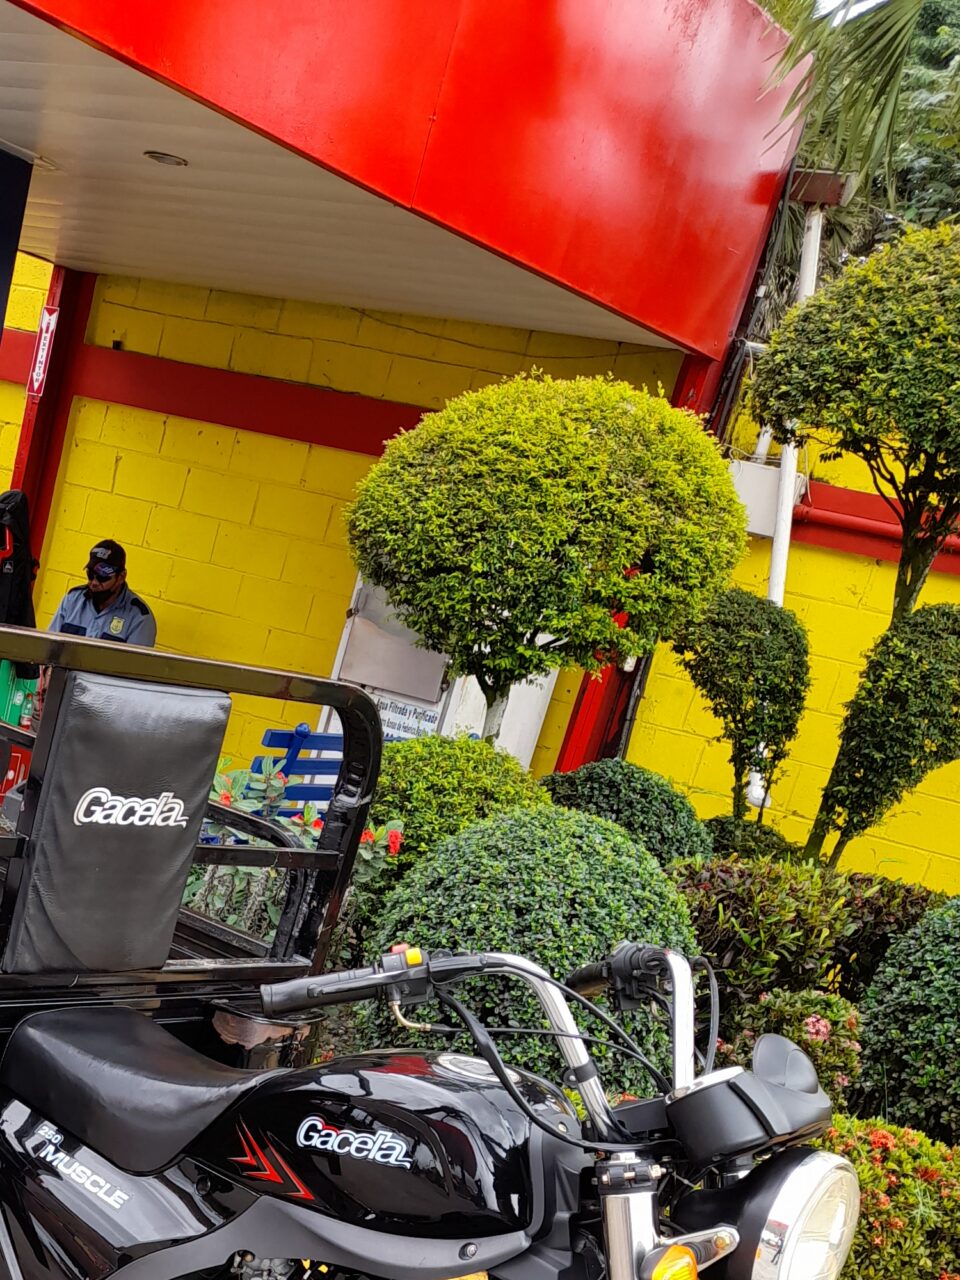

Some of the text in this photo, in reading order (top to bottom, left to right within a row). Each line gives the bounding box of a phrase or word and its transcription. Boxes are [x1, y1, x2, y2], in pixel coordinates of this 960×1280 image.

[35, 336, 48, 382] EXTINTOR
[73, 787, 189, 828] Gacela
[35, 1124, 63, 1146] 250
[295, 1113, 413, 1170] Gacela
[40, 1144, 131, 1211] MUSCLE
